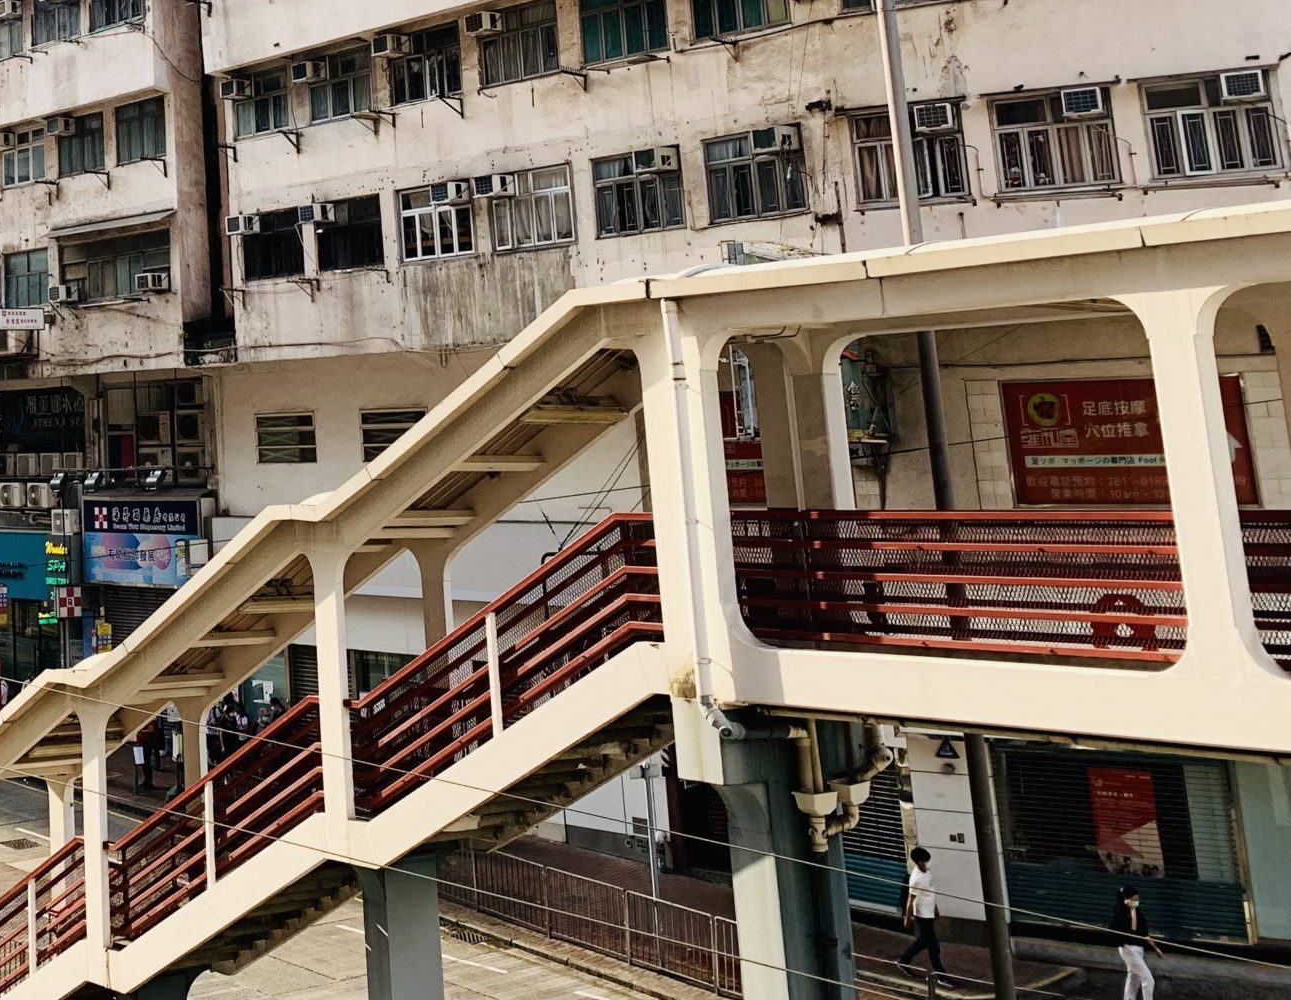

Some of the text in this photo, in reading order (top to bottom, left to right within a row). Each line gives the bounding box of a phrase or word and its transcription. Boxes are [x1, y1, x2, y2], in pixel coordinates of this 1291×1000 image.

[1082, 400, 1147, 417] 足底按摩
[1084, 422, 1149, 438] 穴位推拿
[47, 559, 66, 572] SPA
